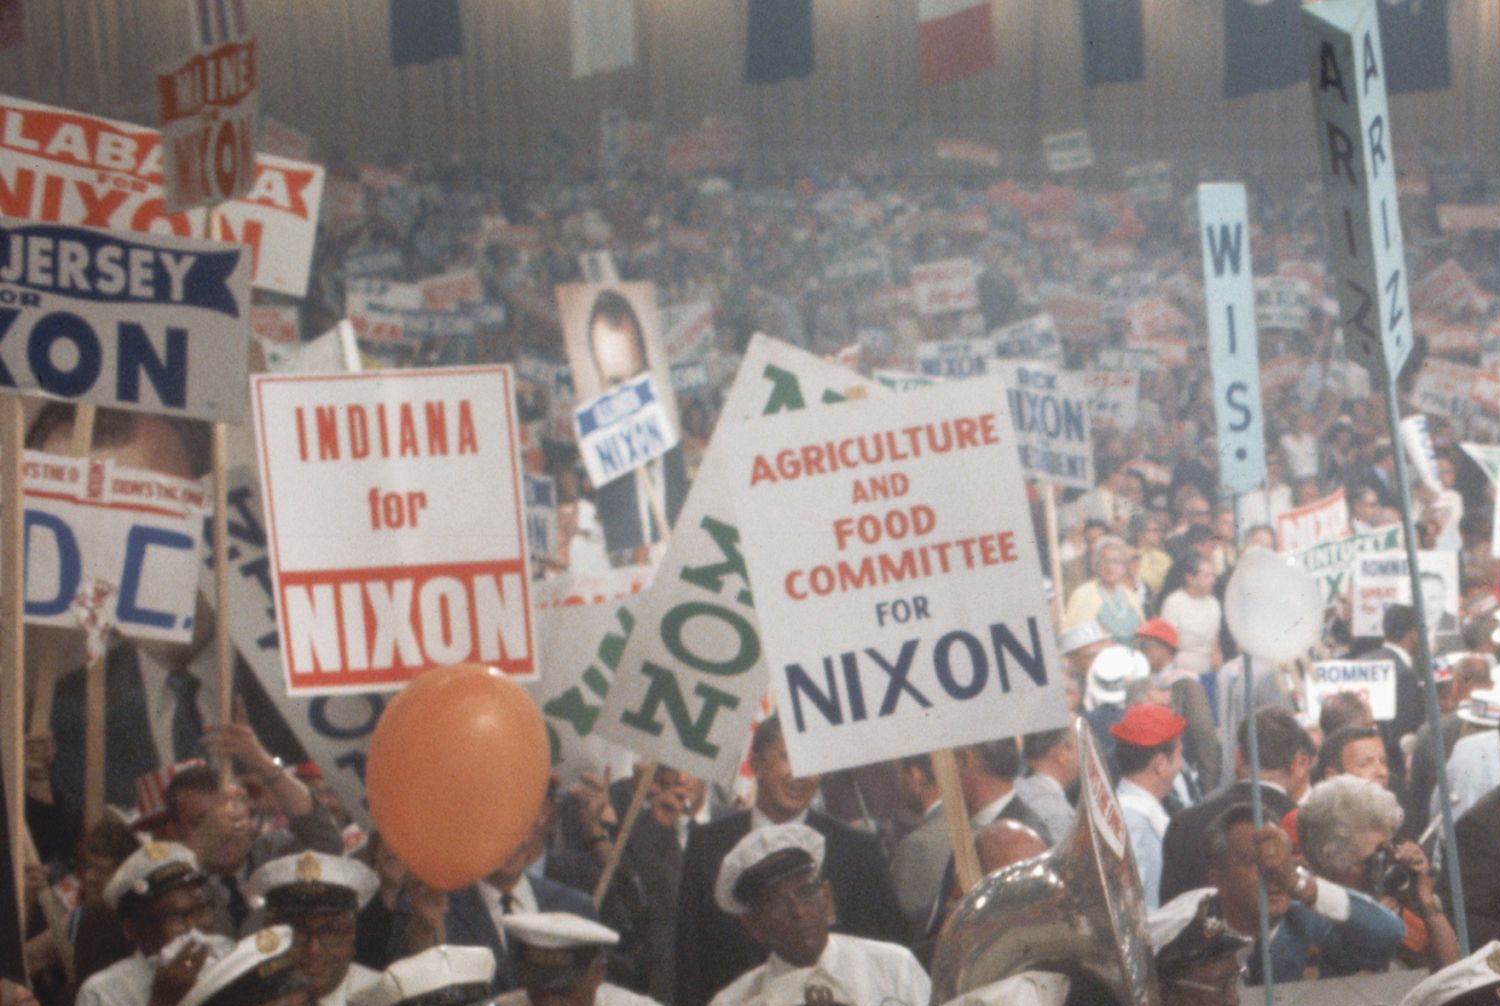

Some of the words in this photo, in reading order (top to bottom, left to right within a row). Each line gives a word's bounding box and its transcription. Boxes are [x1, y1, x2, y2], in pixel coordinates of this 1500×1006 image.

[1319, 38, 1379, 357] ARIZ.
[1, 233, 197, 302] JERSEY
[1206, 222, 1252, 461] WIS.
[295, 399, 479, 462] INDIANA
[748, 412, 1000, 487] AGRICULTURE
[367, 486, 428, 531] for
[850, 473, 911, 506] AND
[832, 504, 936, 551] FOOD
[783, 530, 1019, 601] COMMITTEE
[285, 571, 528, 675] NIXON
[874, 595, 932, 628] FOR
[783, 615, 1049, 734] NIXON
[1315, 664, 1391, 683] ROMNEY
